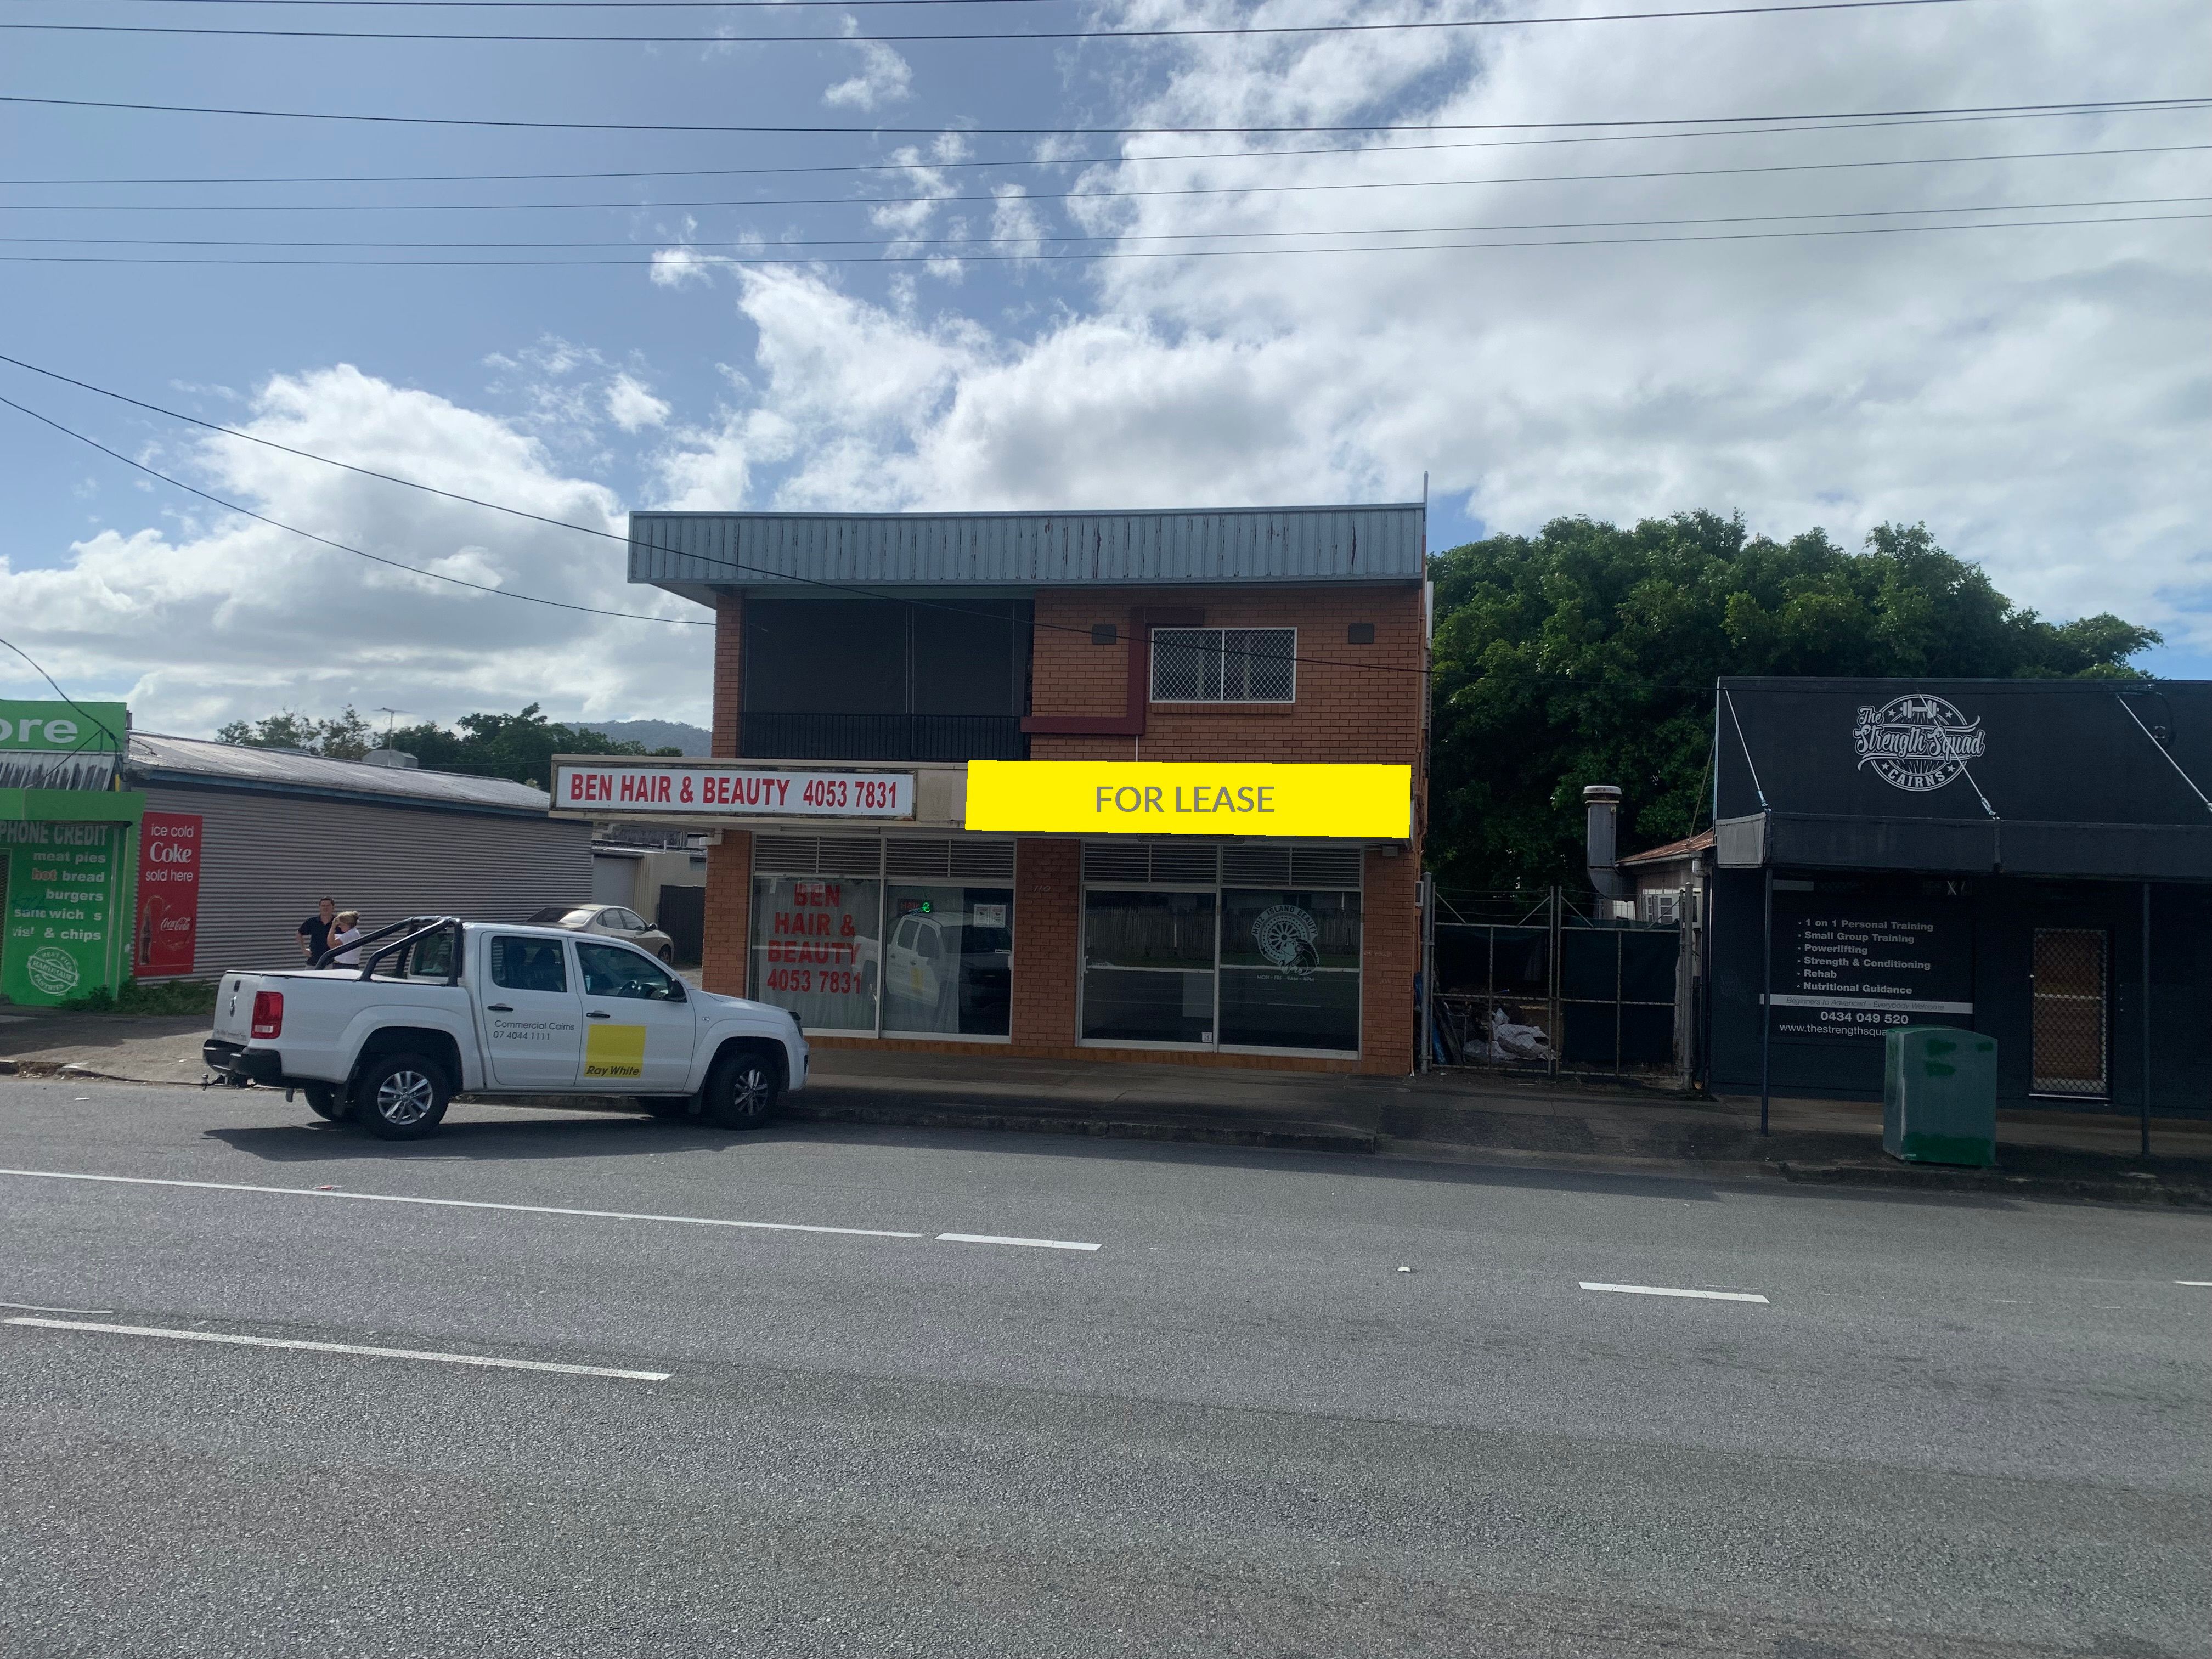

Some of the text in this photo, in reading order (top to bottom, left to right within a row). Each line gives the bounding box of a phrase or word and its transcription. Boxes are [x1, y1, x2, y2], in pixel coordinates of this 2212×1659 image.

[1853, 706, 1984, 763] The Strength Squad
[1888, 769, 1946, 787] CAIRNS
[570, 774, 896, 809] BEN HAIR & BEAUTY 4053 7831
[54, 824, 108, 845] CREDIT
[151, 824, 194, 838] ice cold
[33, 852, 106, 865] meat pies
[149, 842, 192, 863] Coke
[32, 868, 105, 882] hot bread
[145, 869, 193, 882] sold here
[46, 889, 104, 902] burgers
[794, 883, 840, 907] BEN
[775, 912, 855, 936] HAIR &
[1266, 906, 1294, 915] ISLAND
[1297, 910, 1317, 934] BEAUTY
[1841, 920, 1887, 929] Personal
[1891, 921, 1934, 932] Training
[43, 927, 55, 939] &
[60, 929, 101, 941] chips
[1804, 932, 1914, 944] Small Group Training
[768, 940, 862, 965] BEAUTY
[1804, 944, 1868, 955] Powerlifting
[1804, 957, 1931, 970] Strength & Conditioning
[1804, 969, 1837, 978] Rehab
[767, 969, 861, 994] 4053 7831
[1803, 982, 1912, 994] Nutritional Guidance
[1786, 997, 1821, 1007] Beginners
[1831, 998, 1866, 1007] Advanced
[1873, 1001, 1909, 1011] Everybody
[1911, 1002, 1944, 1011] Welcome
[1820, 1011, 1909, 1024] 0434 049 520
[494, 1019, 575, 1031] Commercial Cairns
[1780, 1023, 1887, 1037] www.thestrengthsqua
[493, 1031, 550, 1041] 07 4044 1111
[586, 1066, 640, 1077] Ray White
